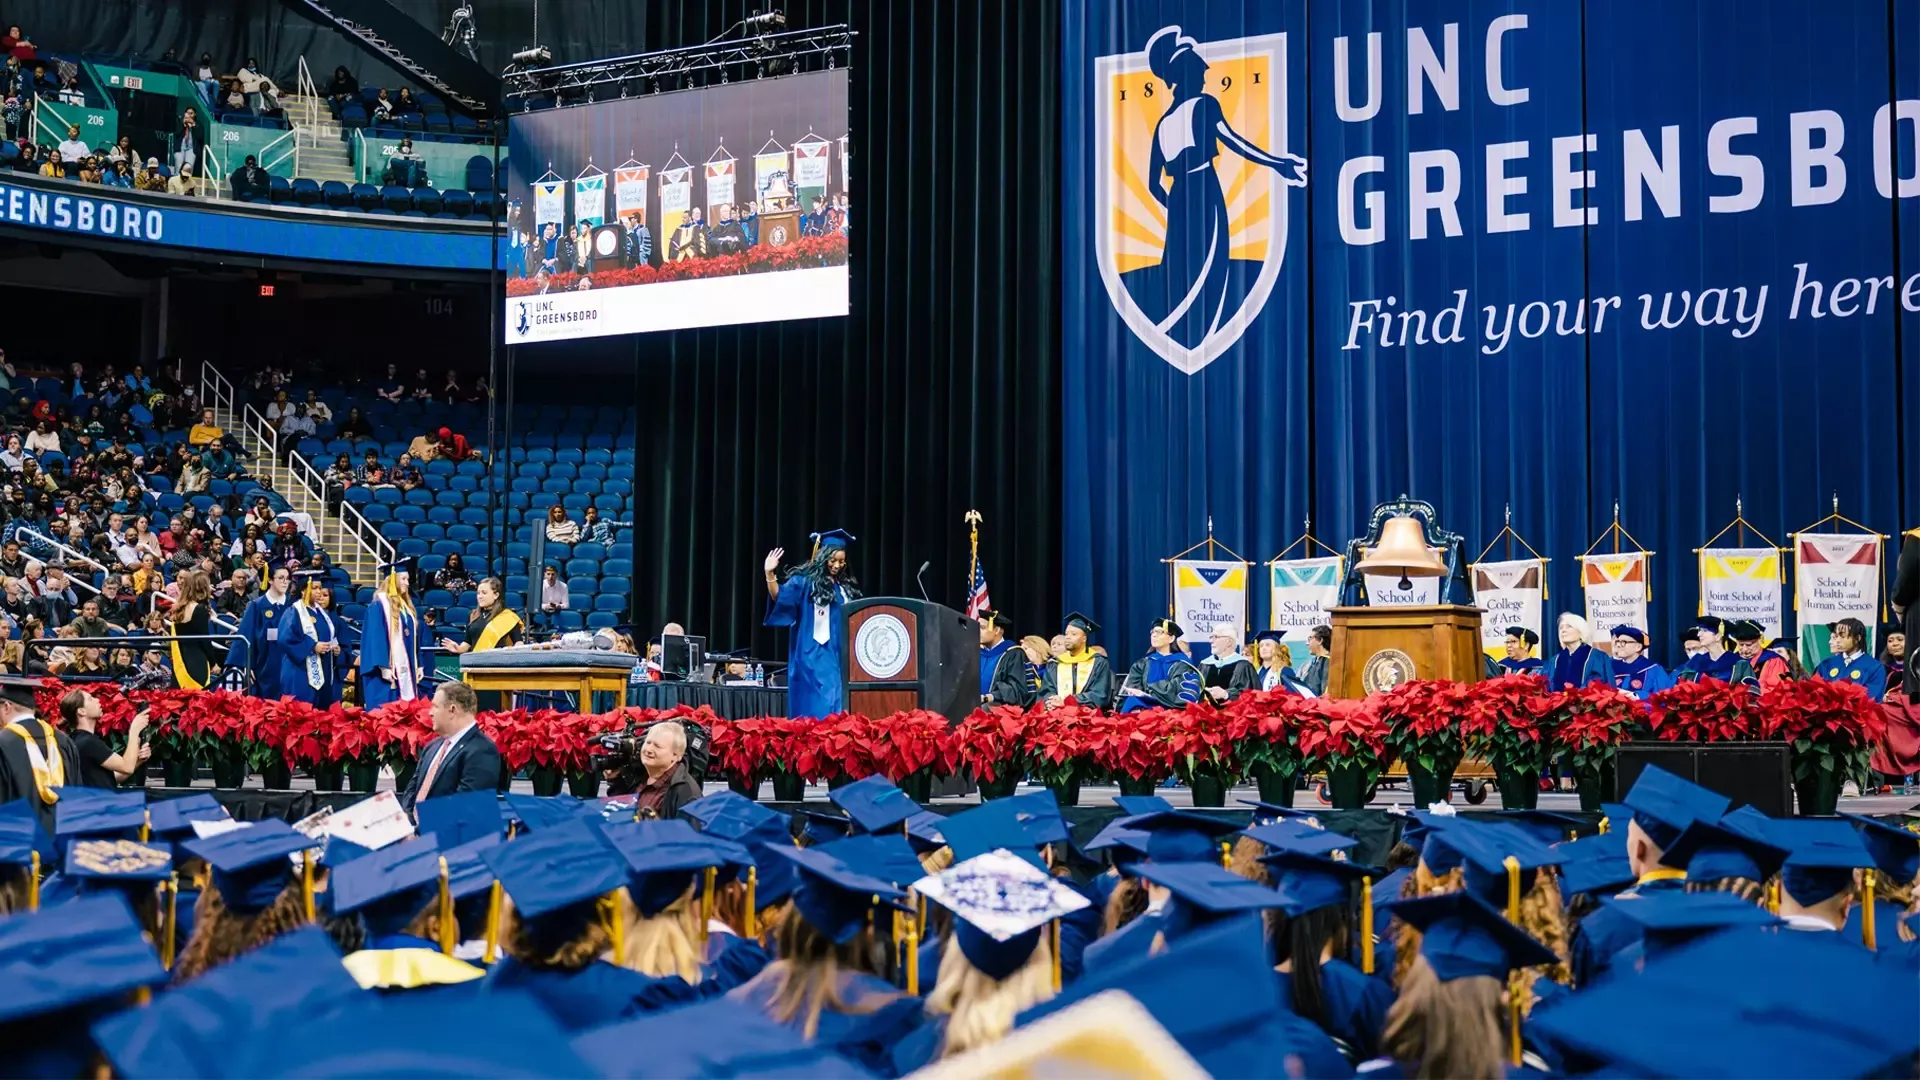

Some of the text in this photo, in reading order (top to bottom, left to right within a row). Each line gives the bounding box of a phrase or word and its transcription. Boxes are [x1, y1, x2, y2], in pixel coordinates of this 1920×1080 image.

[1333, 13, 1529, 123] UNC
[127, 77, 140, 88] EXIT
[87, 114, 104, 126] 206
[223, 130, 240, 142] 206
[261, 285, 274, 296] EXIT
[424, 296, 454, 316] 104
[536, 301, 554, 312] UNC
[1341, 263, 1920, 355] Find your way here
[536, 309, 598, 325] GREENSBORO
[1816, 577, 1857, 588] School of
[1376, 590, 1428, 604] School of
[1708, 590, 1772, 601] Joint School of
[1813, 588, 1862, 599] Health and
[1200, 598, 1221, 610] The
[1283, 600, 1319, 612] School
[1486, 598, 1524, 612] College
[1761, 603, 1775, 612] and
[1187, 609, 1235, 622] Graduate
[1490, 613, 1522, 625] of Arts
[1592, 608, 1626, 618] Business
[1194, 621, 1214, 633] Sch
